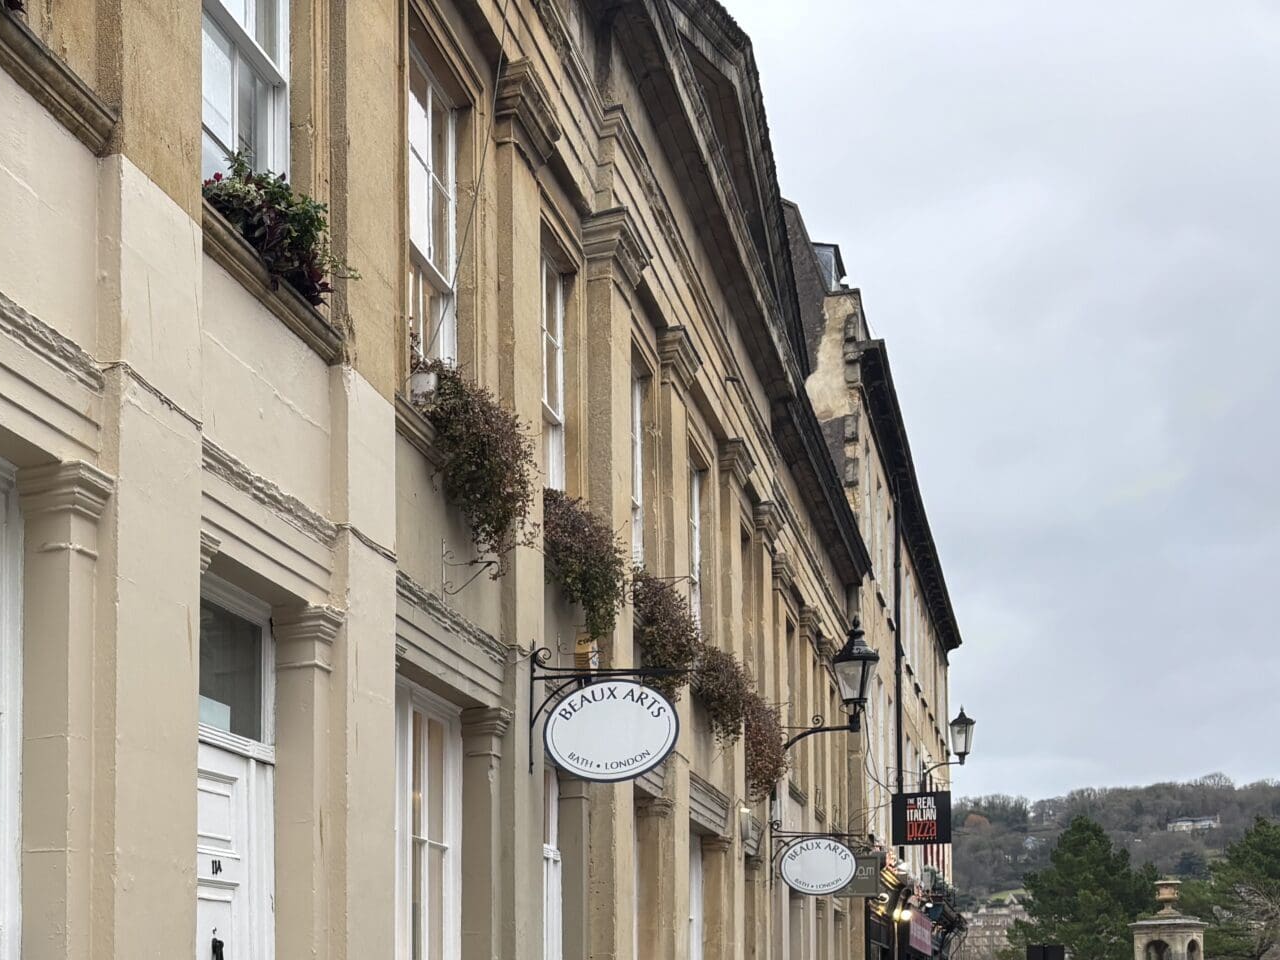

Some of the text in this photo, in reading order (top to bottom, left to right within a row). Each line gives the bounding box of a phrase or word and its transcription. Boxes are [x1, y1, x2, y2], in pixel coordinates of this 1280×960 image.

[558, 686, 666, 721] BEAUX ARTS
[567, 749, 651, 770] BATH LONDON
[917, 796, 937, 809] REAL
[906, 808, 937, 822] ITALIAN
[787, 841, 850, 861] BEAUX ARTS
